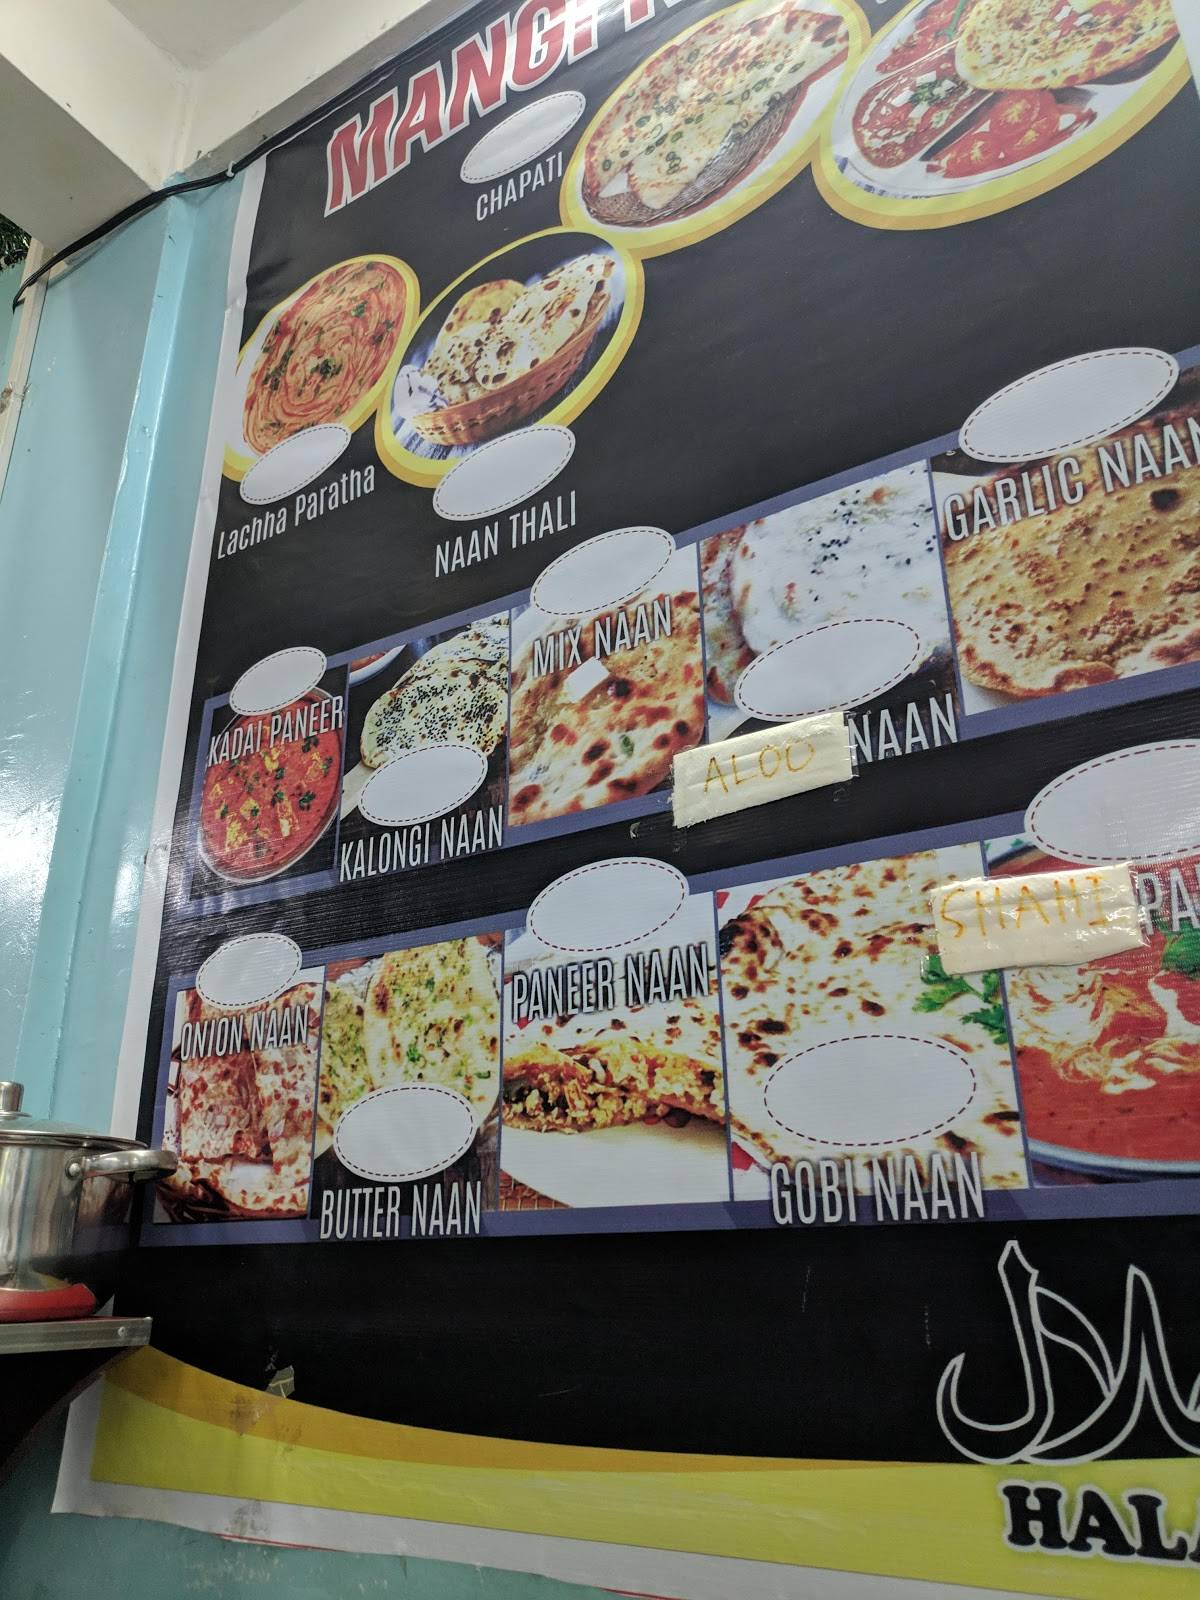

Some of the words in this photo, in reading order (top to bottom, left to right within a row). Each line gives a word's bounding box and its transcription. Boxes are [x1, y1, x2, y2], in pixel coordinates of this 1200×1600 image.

[476, 155, 564, 221] CHAPATI
[217, 507, 287, 559] Lachha
[295, 465, 376, 528] Paratha
[434, 522, 499, 578] NAAN
[509, 491, 577, 549] THALI
[944, 457, 1084, 541] GARLIC
[532, 627, 582, 678] MIX
[594, 596, 673, 660] NAAN
[207, 719, 264, 767] KADAI
[269, 696, 344, 747] PANEER
[703, 739, 815, 793] ALOO
[848, 693, 959, 766] NAAN
[339, 819, 430, 882] KALONGI
[440, 805, 503, 861] NAAN
[1137, 863, 1200, 935] PA
[513, 957, 614, 1023] PANEER
[625, 944, 710, 1008] NAAN
[180, 1016, 243, 1061] ONION
[251, 1005, 309, 1051] NAAN
[319, 1185, 401, 1240] BUTTER
[410, 1181, 482, 1236] NAAN
[771, 1158, 856, 1225] GOBI
[871, 1152, 985, 1222] NAAN
